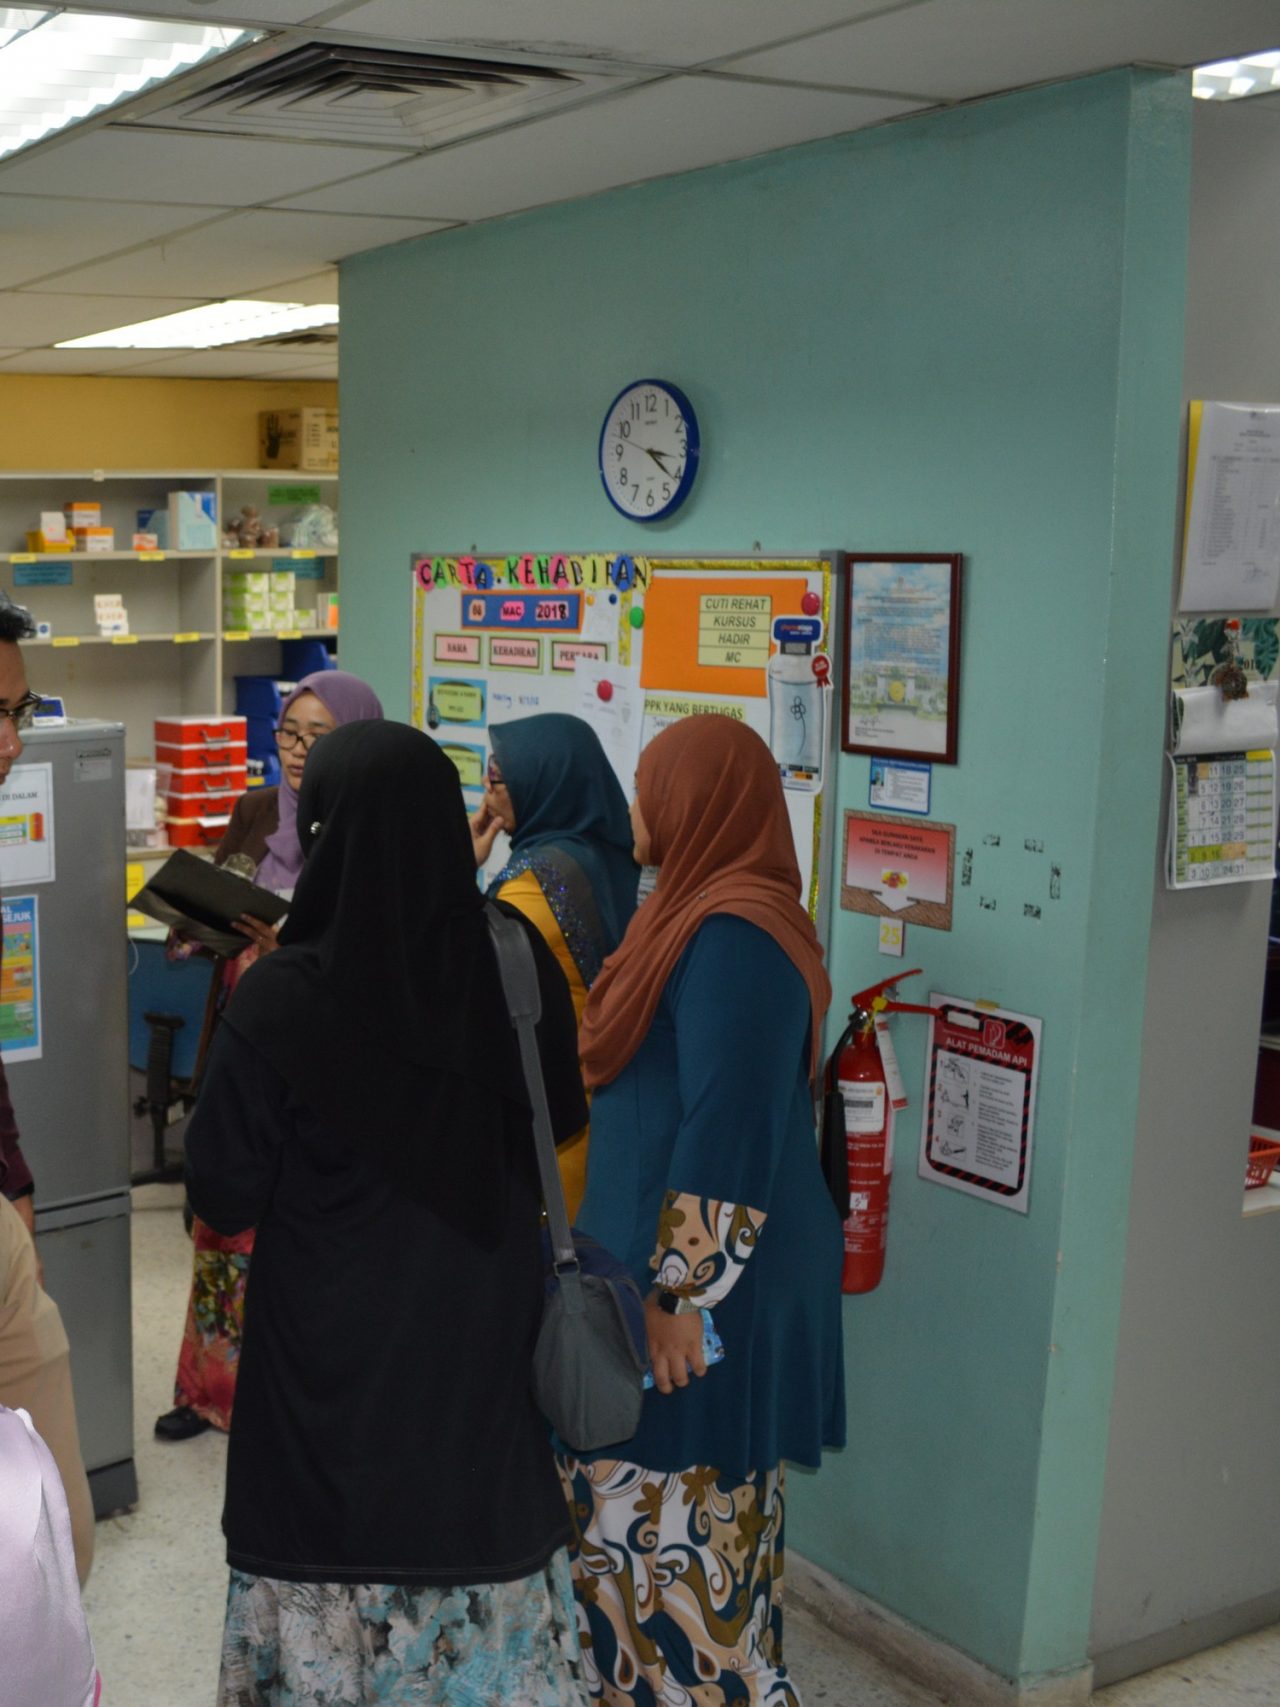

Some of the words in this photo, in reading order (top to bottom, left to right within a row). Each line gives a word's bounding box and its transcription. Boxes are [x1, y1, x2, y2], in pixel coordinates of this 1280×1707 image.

[631, 400, 640, 420] 11
[644, 394, 658, 412] 12
[664, 400, 669, 417] 1
[618, 420, 631, 439] 10
[674, 415, 684, 434] 2
[615, 444, 624, 462] 9
[679, 439, 688, 458] 3
[620, 467, 628, 486] 8
[673, 464, 682, 481] 4
[631, 484, 639, 502] 7
[646, 489, 655, 507] 6
[662, 483, 671, 501] 5
[419, 561, 489, 588] CARTA
[503, 606, 522, 617] MAC
[536, 603, 567, 619] 2018
[705, 598, 729, 610] CUTI
[731, 599, 766, 611] REHAT
[713, 616, 757, 628] KURSUS
[718, 633, 751, 645] HADIR
[724, 651, 741, 664] MC
[645, 699, 661, 711] PPK
[663, 702, 690, 714] YANG
[968, 1043, 1011, 1062] PEMADAM
[1011, 1055, 1028, 1067] API
